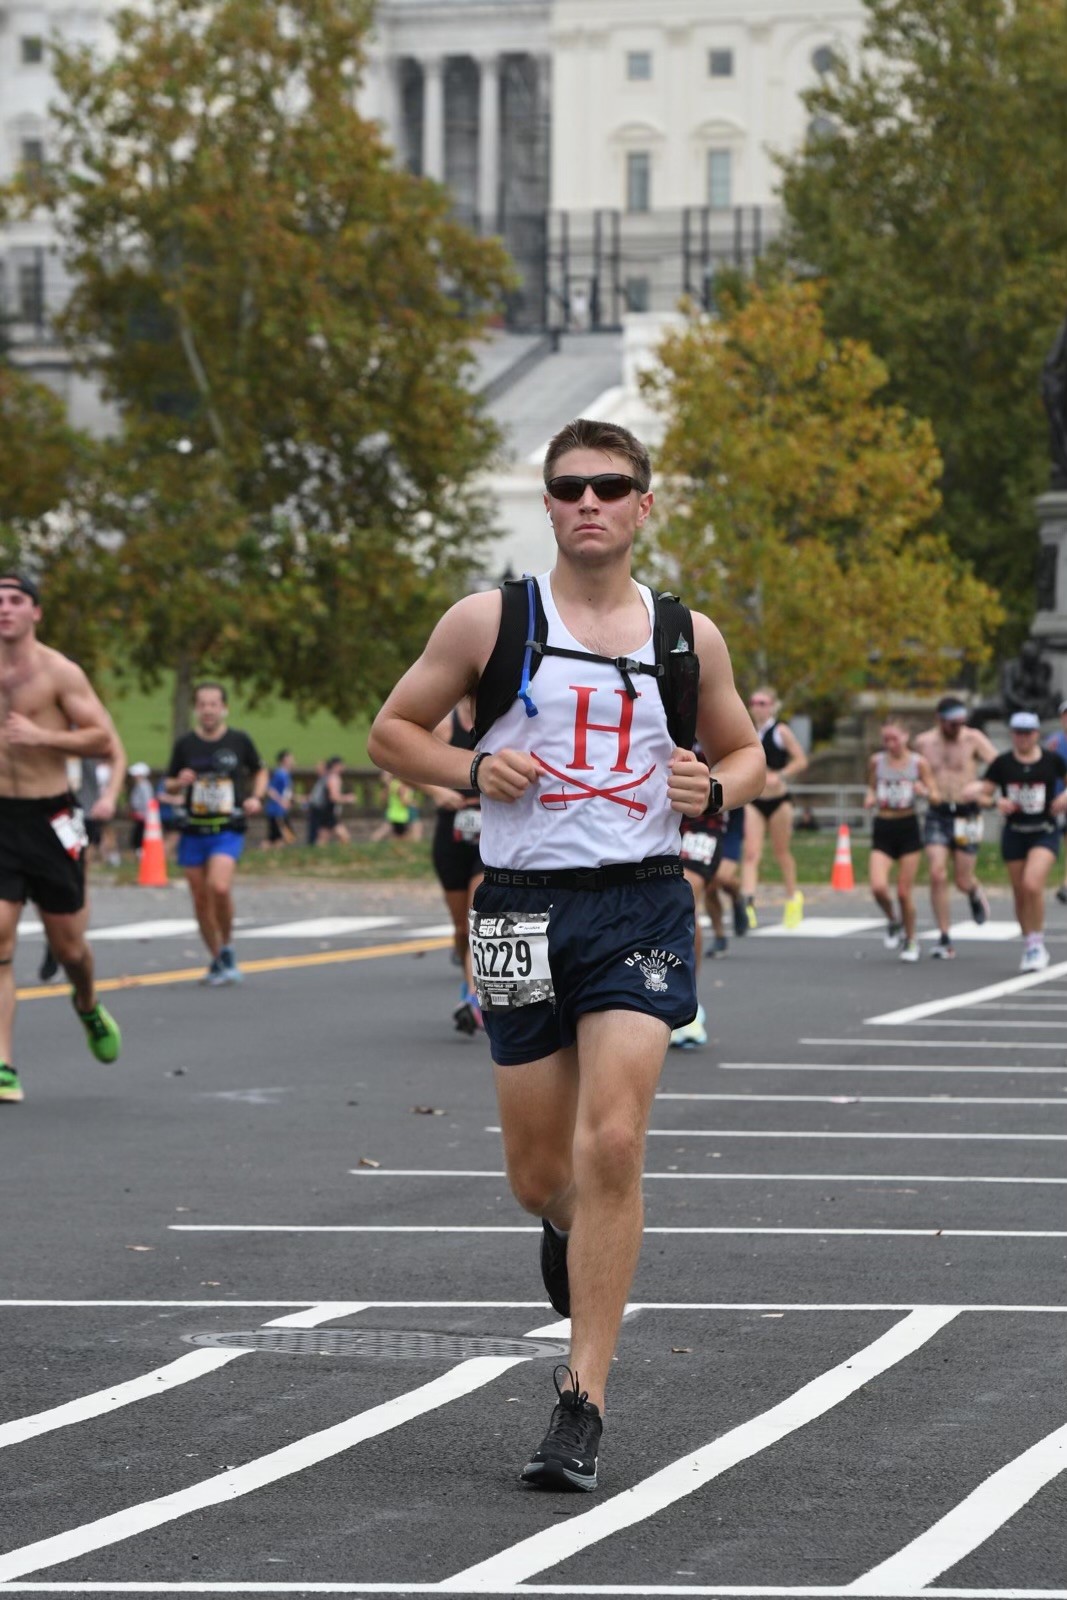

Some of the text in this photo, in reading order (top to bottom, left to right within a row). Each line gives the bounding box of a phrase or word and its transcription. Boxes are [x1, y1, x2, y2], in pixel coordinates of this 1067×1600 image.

[566, 685, 641, 774] H
[480, 918, 497, 926] MCM
[473, 939, 532, 978] 51229
[624, 949, 682, 968] U.S. NAVY
